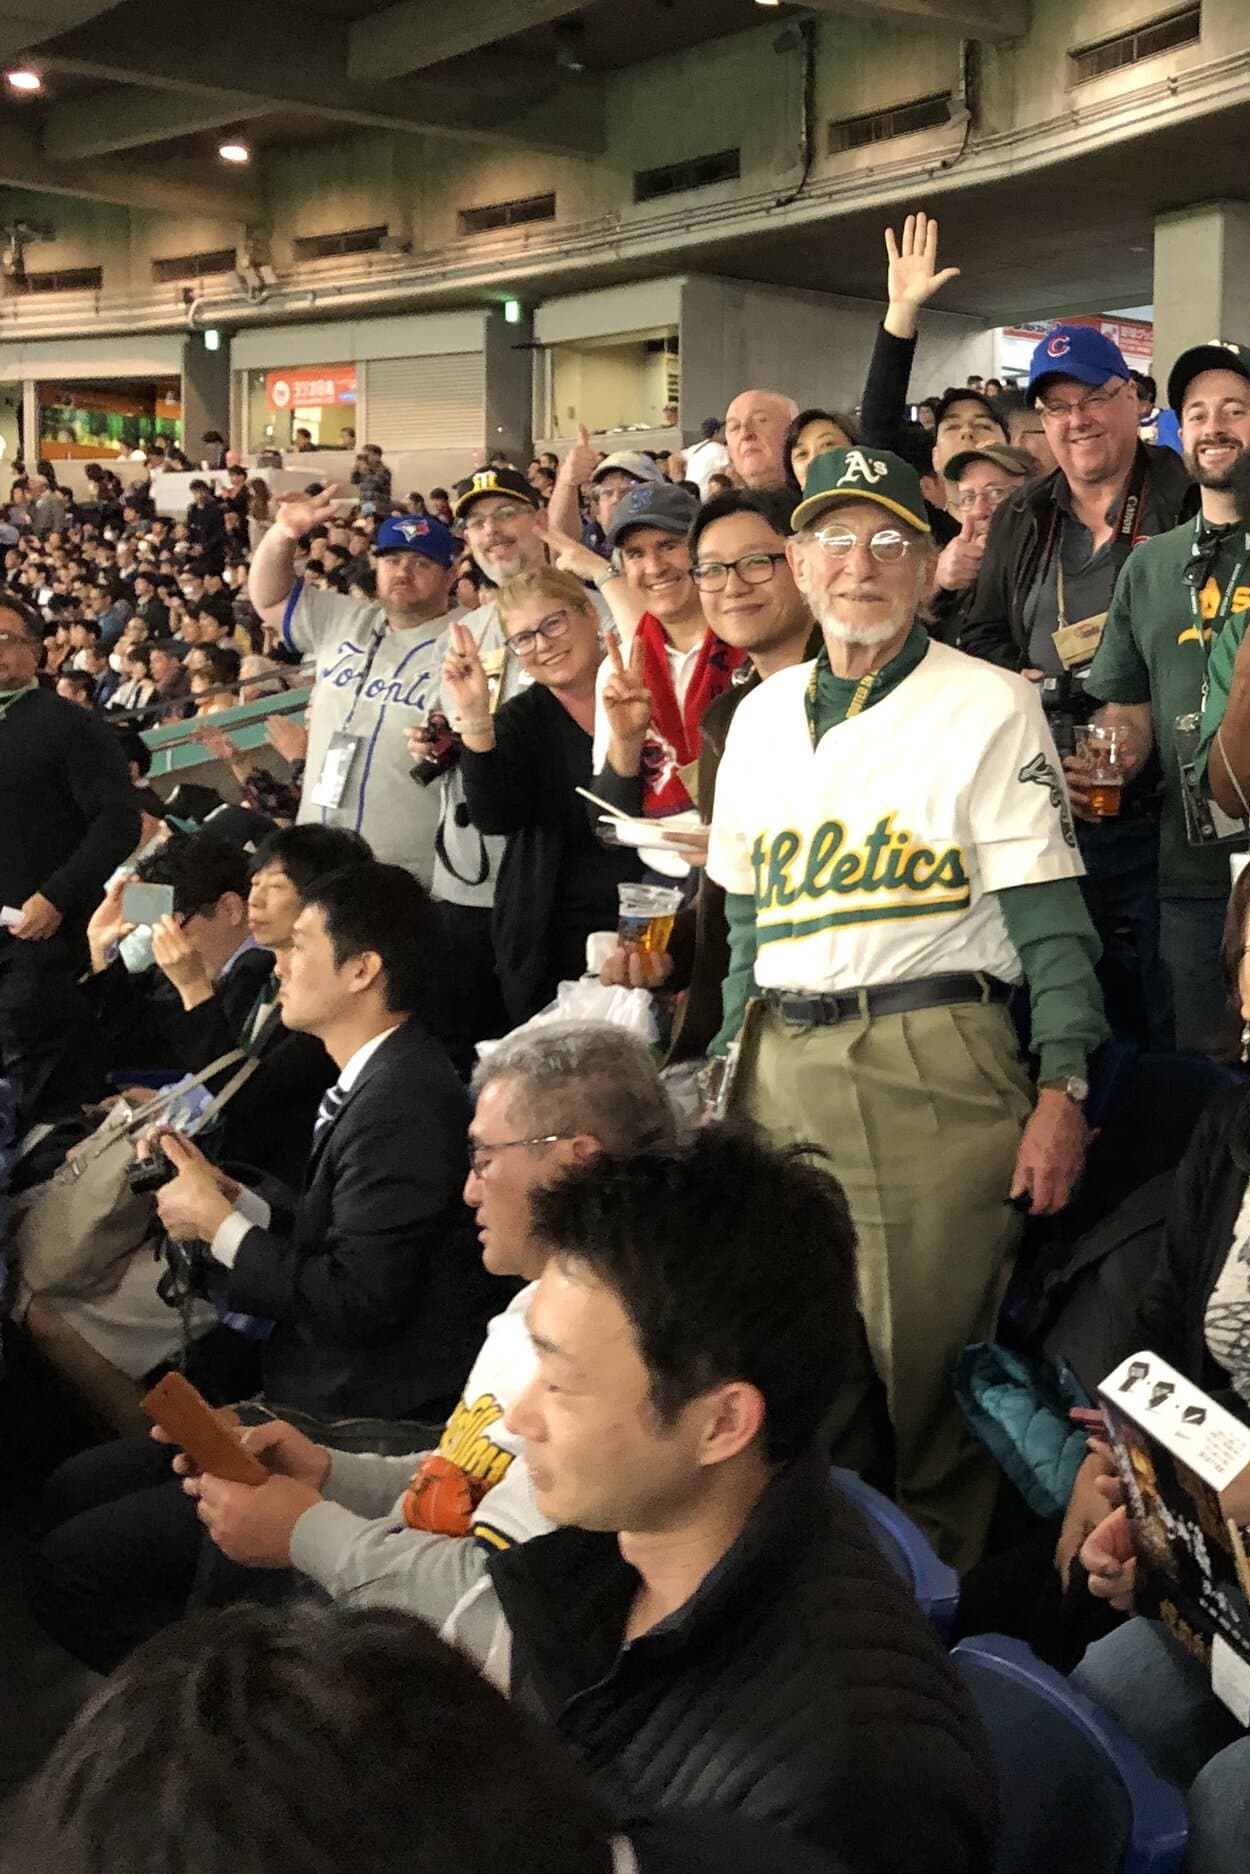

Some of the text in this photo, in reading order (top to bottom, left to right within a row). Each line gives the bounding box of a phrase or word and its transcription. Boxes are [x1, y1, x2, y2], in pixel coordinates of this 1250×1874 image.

[1046, 335, 1070, 358] C
[836, 450, 889, 487] A's
[1121, 495, 1138, 534] Canon
[322, 640, 426, 711] Toront
[750, 810, 970, 913] thletics
